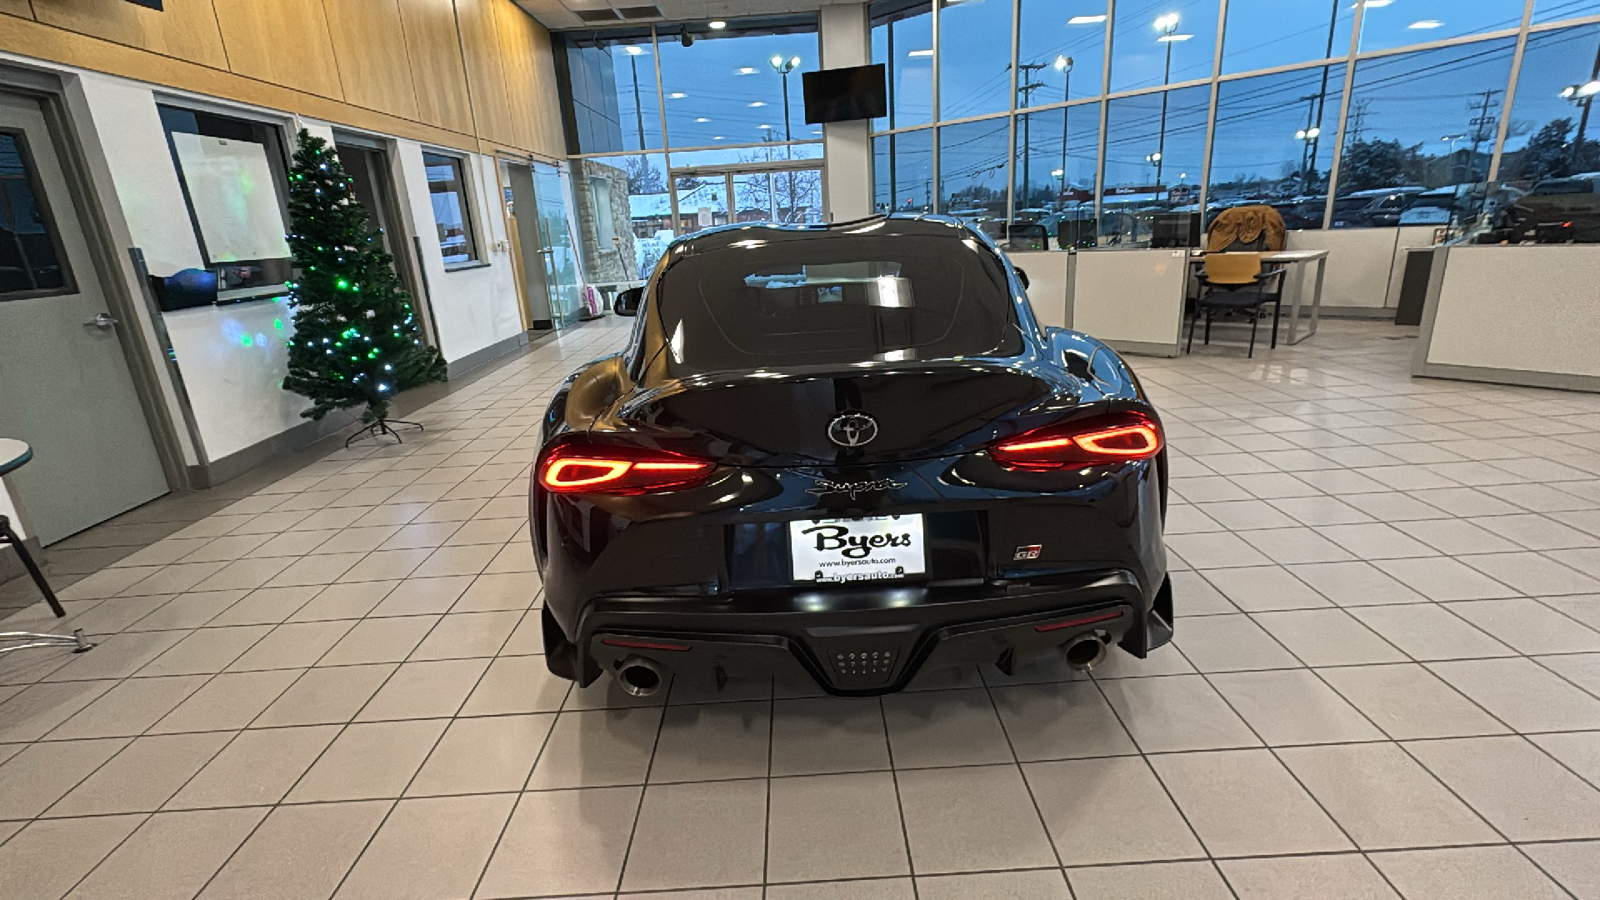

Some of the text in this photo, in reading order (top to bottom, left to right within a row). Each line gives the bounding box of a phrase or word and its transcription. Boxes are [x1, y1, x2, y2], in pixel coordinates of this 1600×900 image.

[804, 477, 908, 501] Supra
[801, 525, 911, 558] Byers
[819, 557, 896, 568] www.byersauto.com
